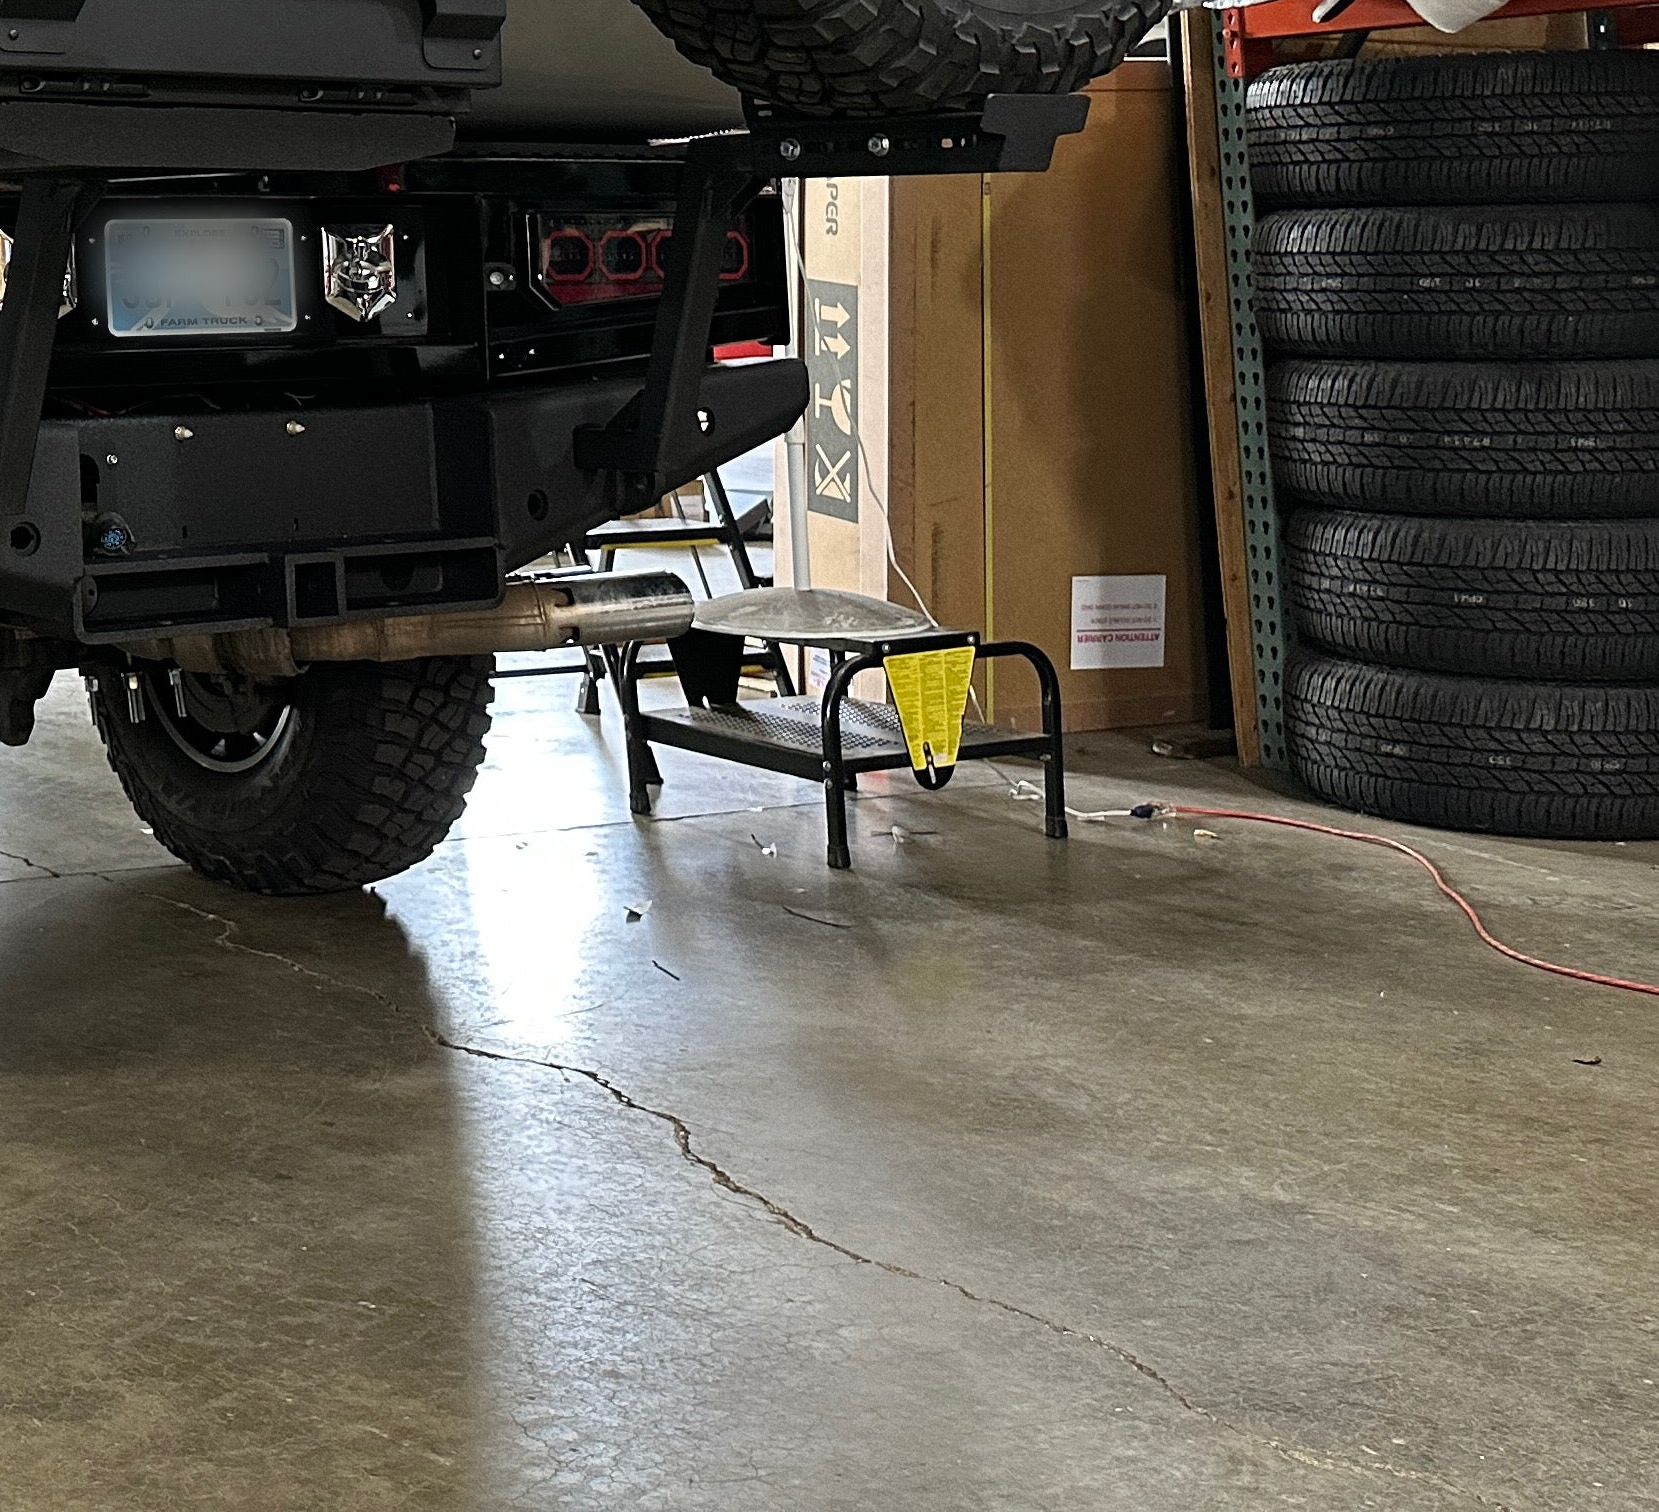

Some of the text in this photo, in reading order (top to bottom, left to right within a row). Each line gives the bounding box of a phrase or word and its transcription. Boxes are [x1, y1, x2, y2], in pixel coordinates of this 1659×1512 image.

[825, 177, 838, 236] PER
[160, 316, 248, 326] FARM TRUCK
[1077, 632, 1160, 643] ATTENTION CARRIER
